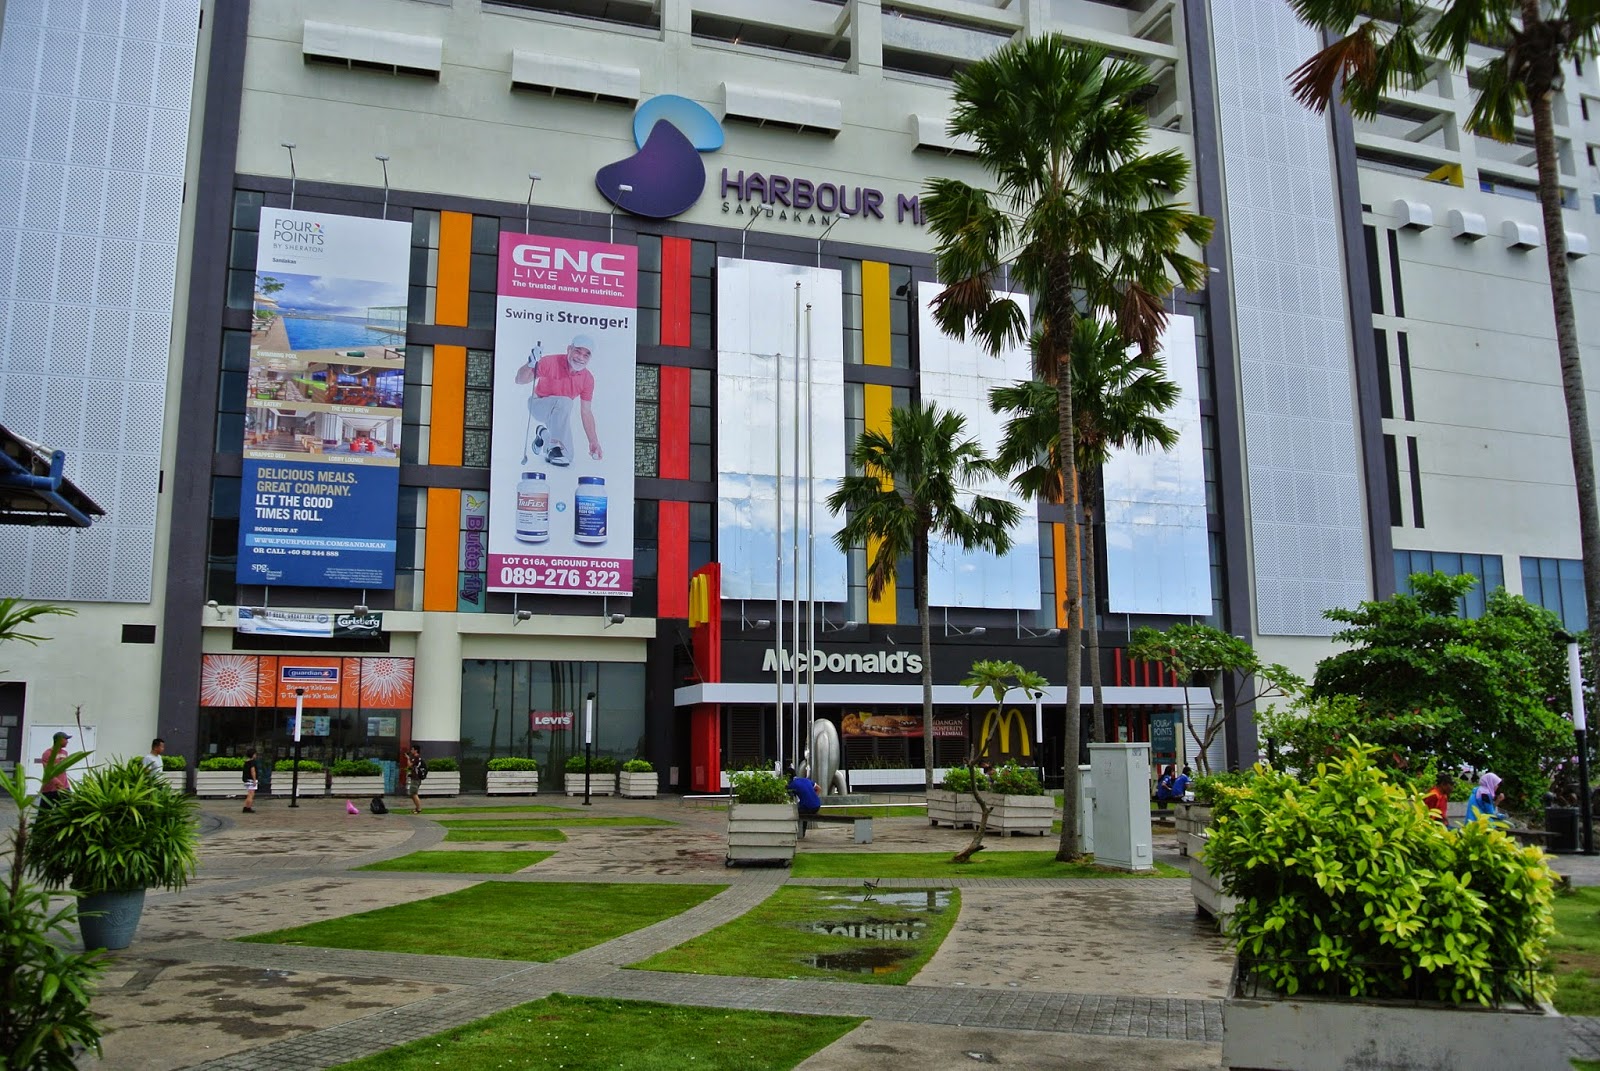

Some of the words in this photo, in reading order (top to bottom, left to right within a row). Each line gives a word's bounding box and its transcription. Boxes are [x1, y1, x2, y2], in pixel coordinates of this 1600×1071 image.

[721, 168, 884, 219] HARBOUR
[722, 201, 830, 226] SANDAKAN
[274, 218, 312, 233] FOUR
[273, 230, 324, 246] POINTS
[284, 244, 324, 253] SHERATON
[512, 244, 625, 276] GNC
[514, 268, 558, 281] LIVE
[571, 273, 624, 288] WELL
[528, 282, 557, 290] trusted
[590, 288, 625, 297] nutrition.
[505, 308, 542, 323] Swing
[546, 311, 554, 322] it
[557, 311, 628, 330] Stronger!
[258, 468, 314, 482] DELICIOUS
[318, 471, 358, 484] MEALS.
[257, 481, 292, 493] GREAT
[295, 483, 351, 496] COMPANY.
[256, 494, 276, 506] LET
[279, 495, 300, 507] THE
[303, 496, 333, 509] GOOD
[255, 507, 290, 520] TIMES
[293, 509, 323, 521] ROLL.
[254, 537, 386, 549] WWW.FOURPOINTS.COM/SANDAKAN
[252, 563, 269, 573] spg.
[460, 515, 485, 606] Butterfly
[522, 558, 548, 567] G16A,
[501, 567, 580, 586] 089-276
[586, 570, 620, 588] 322
[337, 614, 380, 628] Carlsberg
[762, 649, 923, 674] McDonald's
